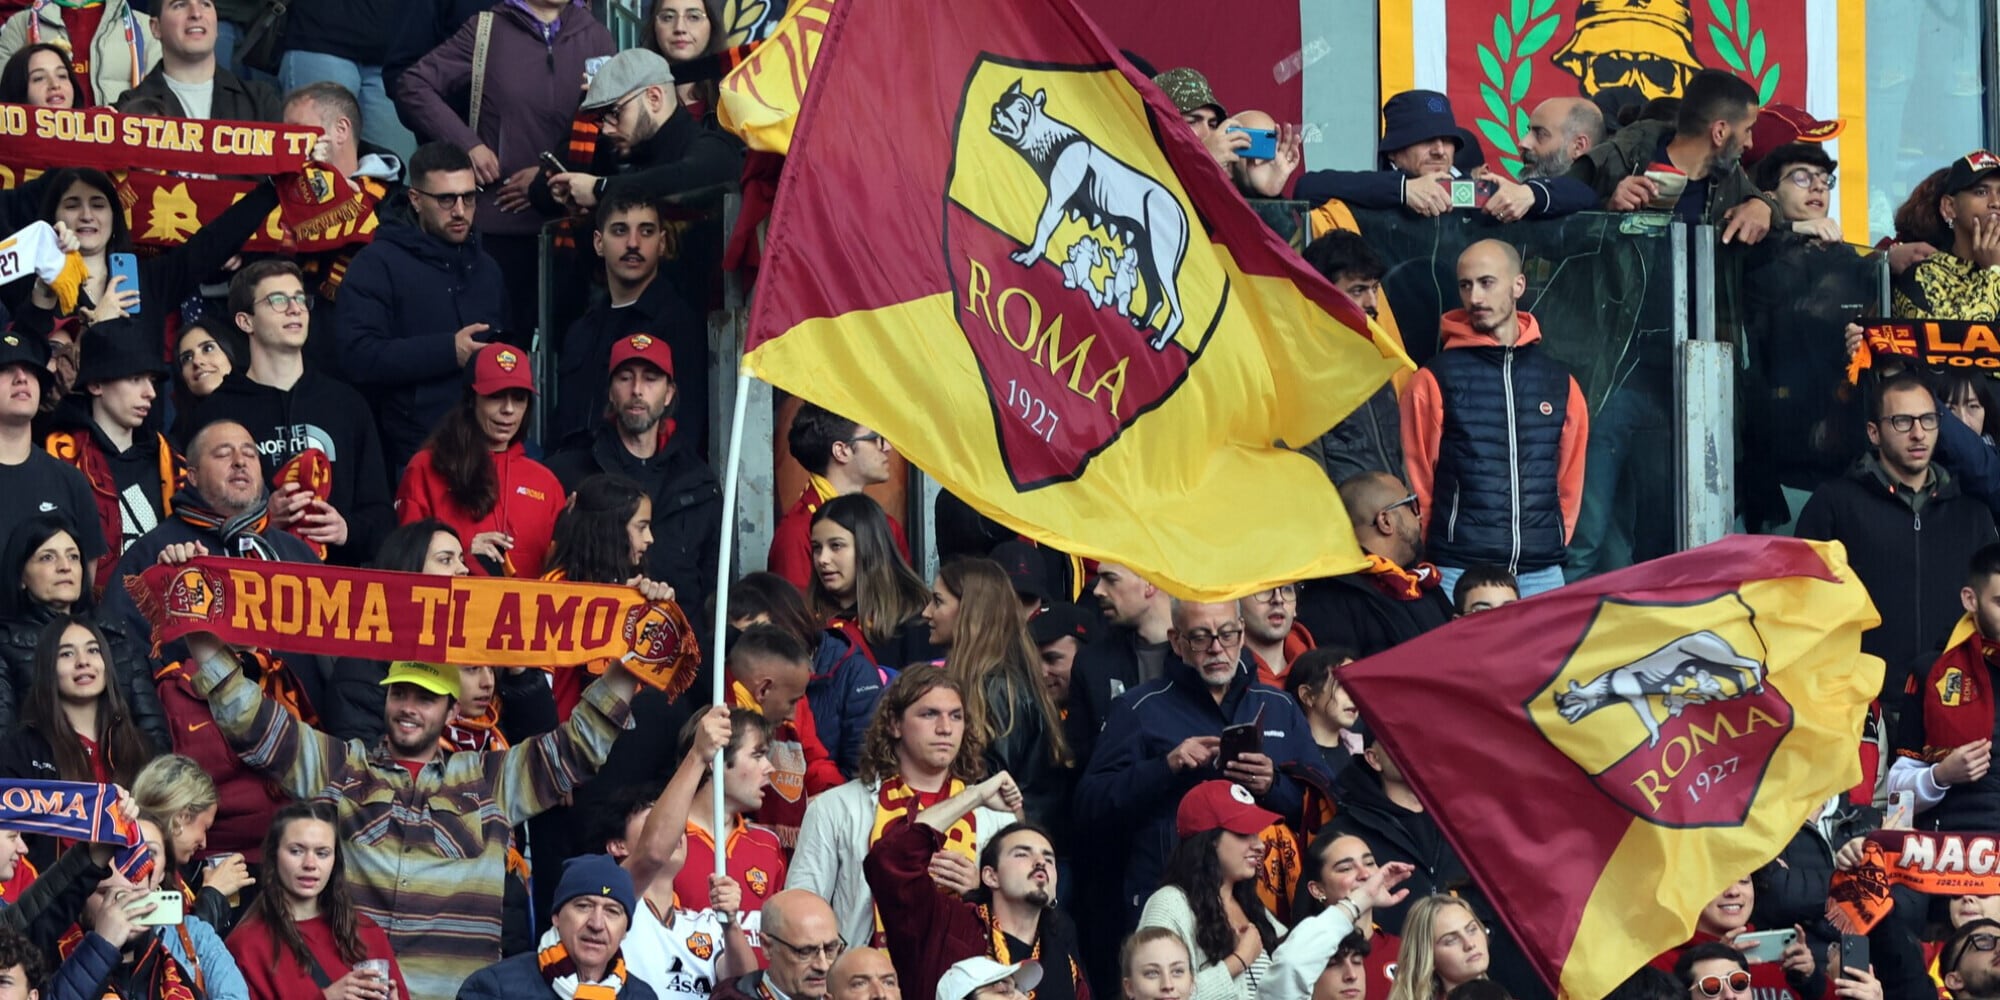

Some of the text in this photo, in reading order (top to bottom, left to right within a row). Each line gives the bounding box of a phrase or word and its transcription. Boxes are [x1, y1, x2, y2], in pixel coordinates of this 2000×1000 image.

[35, 109, 115, 144] SOLO
[122, 116, 204, 152] STAR
[212, 125, 276, 156] CON
[965, 254, 1130, 421] ROMA
[1924, 322, 2000, 352] LA
[1007, 379, 1059, 443] 1927
[229, 568, 621, 652] ROMA TI AMO
[624, 608, 640, 640] ROMA
[1630, 706, 1786, 813] ROMA
[1687, 756, 1740, 804] 1927
